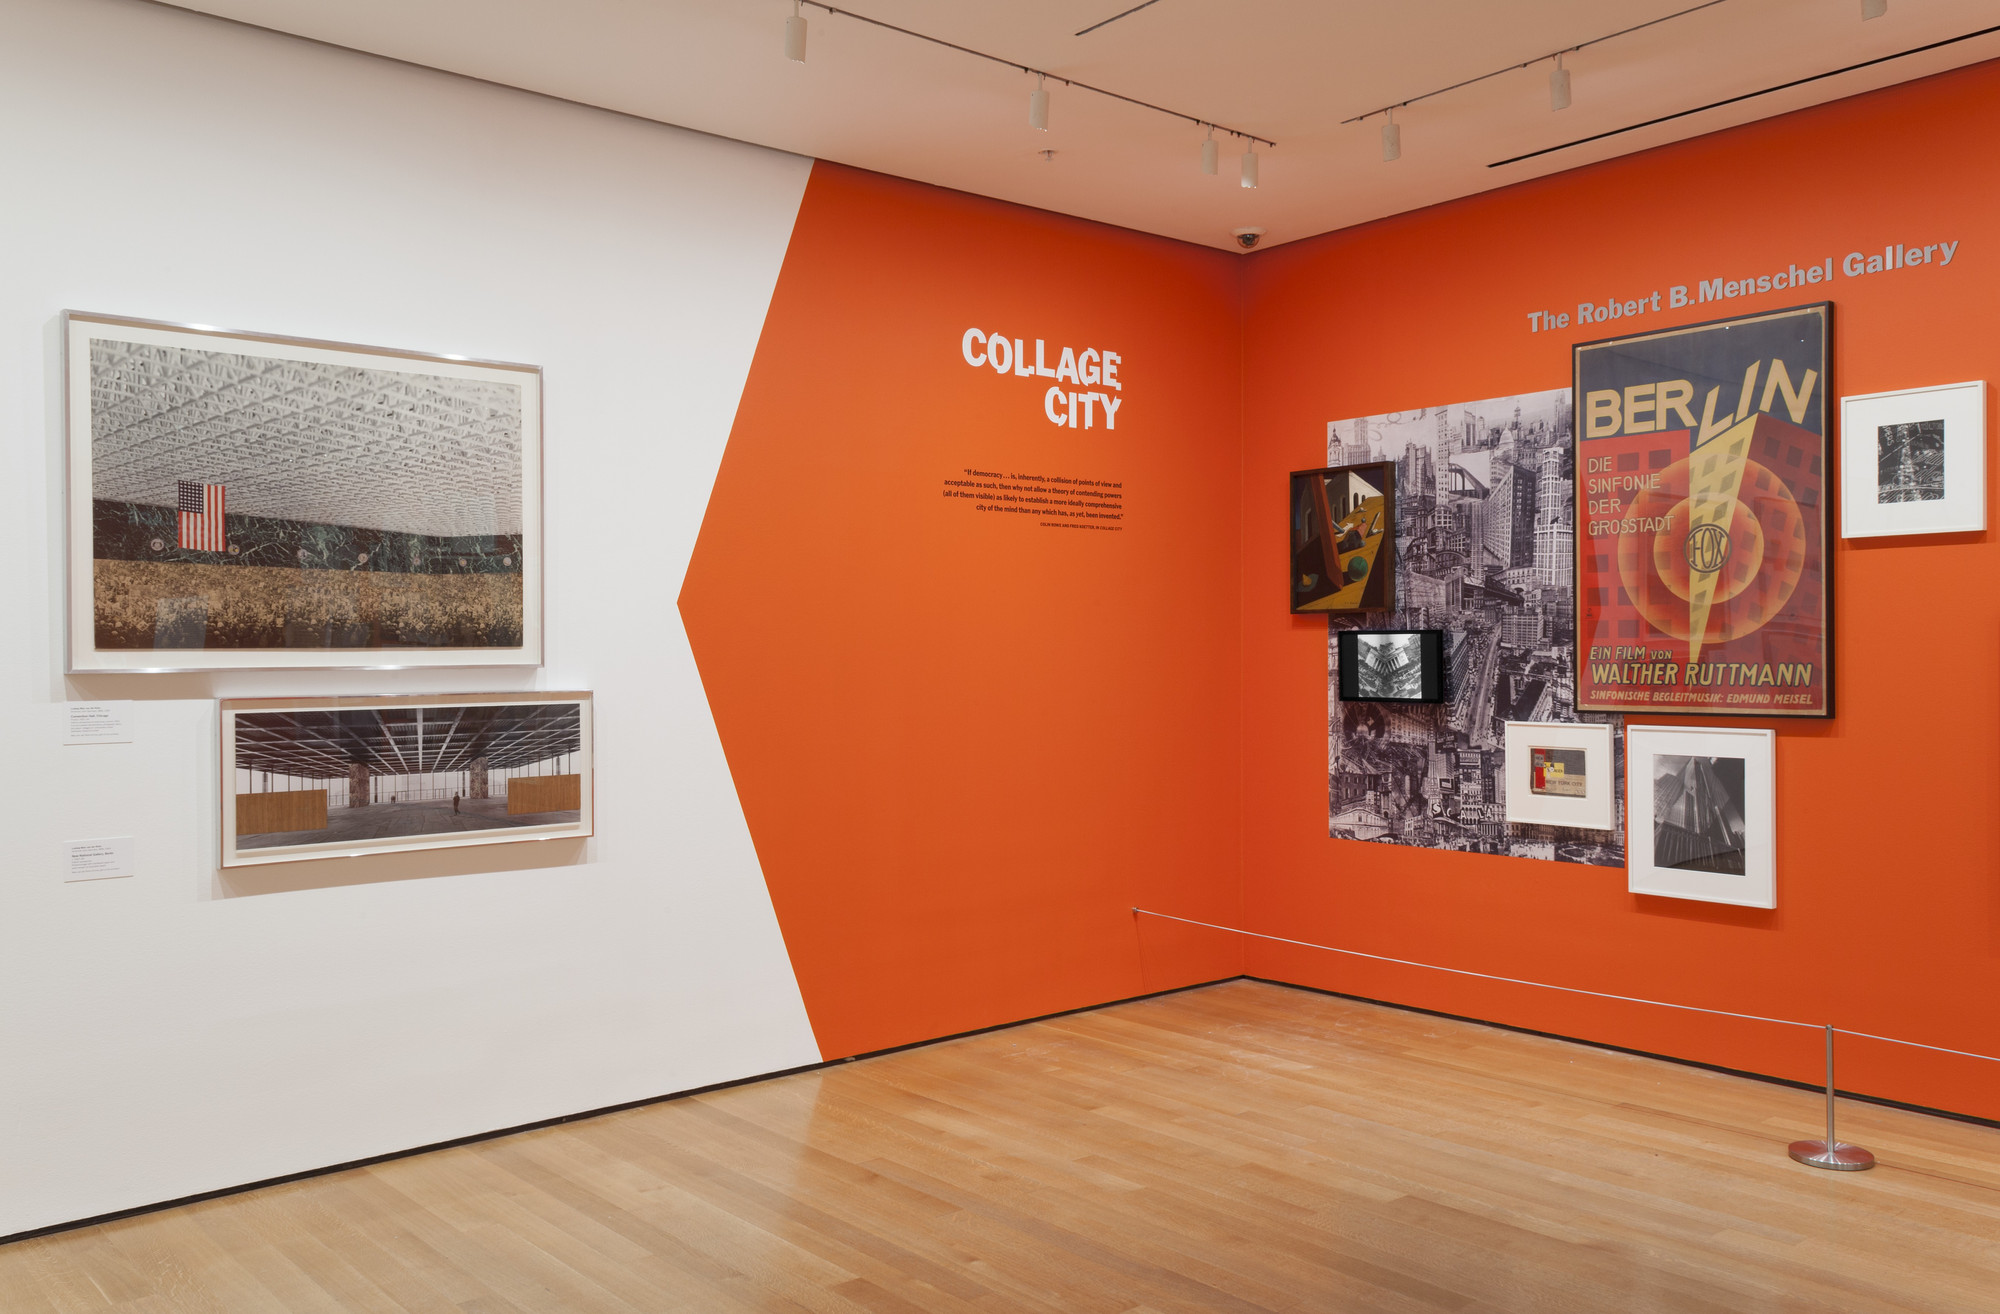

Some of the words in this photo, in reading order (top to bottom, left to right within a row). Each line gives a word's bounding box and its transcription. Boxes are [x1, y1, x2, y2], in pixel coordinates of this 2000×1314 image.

[1527, 311, 1569, 333] The
[1577, 290, 1662, 325] Robert
[1699, 257, 1833, 304] Menschel
[1843, 239, 1960, 278] Gallery
[962, 327, 1122, 391] COLLAGE
[1044, 386, 1122, 430] CITY
[1585, 358, 1818, 447] BERLIN
[1588, 456, 1613, 474] DIE
[944, 479, 975, 488] acceptable
[1052, 487, 1069, 496] theory
[1076, 490, 1104, 499] contending
[1018, 473, 1046, 483] inherently,
[1051, 476, 1072, 484] collision
[1588, 472, 1662, 495] SINFONIE
[942, 489, 952, 497] (all
[975, 492, 995, 500] visible)
[1003, 494, 1018, 502] likely
[1025, 496, 1049, 504] establish
[1068, 499, 1084, 507] ideally
[1085, 501, 1122, 509] comprehensive
[976, 504, 986, 512] city
[1004, 505, 1018, 513] mind
[1588, 499, 1621, 515] DER
[1588, 515, 1676, 537] GROSSTADT
[1688, 528, 1729, 569] FOX
[1590, 645, 1613, 661] EIN
[1615, 646, 1646, 661] FILM
[1591, 662, 1678, 687] WALTHER
[1685, 662, 1813, 687] RUTTMANN
[1590, 689, 1650, 702] SINFONISCHE
[1653, 690, 1724, 704] BEGLEITMUSIK:
[1726, 691, 1770, 705] EDMUND
[1774, 691, 1813, 705] MEISEL
